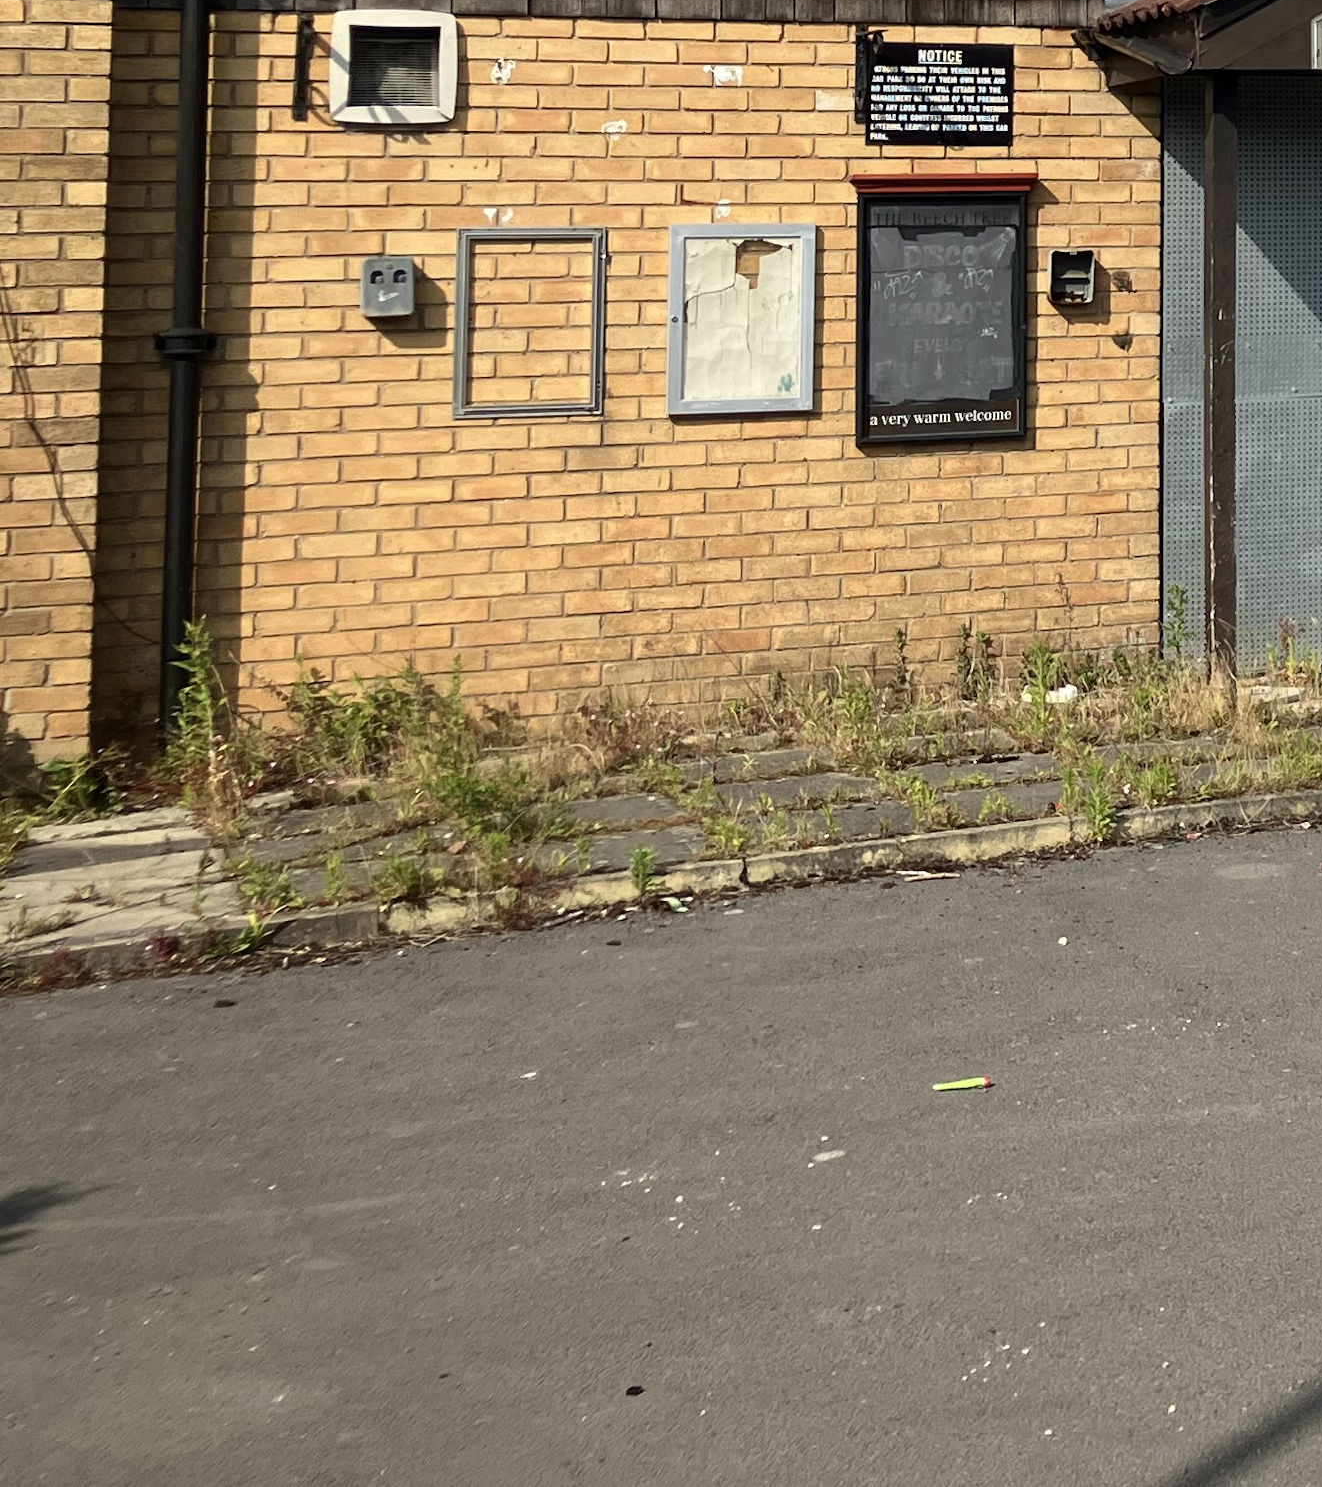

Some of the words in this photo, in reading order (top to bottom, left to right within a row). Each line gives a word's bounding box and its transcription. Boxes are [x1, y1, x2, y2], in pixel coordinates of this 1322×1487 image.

[918, 49, 963, 62] NOTICE
[900, 66, 927, 74] PARKING
[929, 66, 948, 74] THEIR
[950, 67, 980, 75] VEHICLES
[991, 67, 1006, 75] THIS
[928, 76, 936, 84] AT
[939, 76, 958, 84] THEIR
[976, 76, 992, 85] RISK
[993, 76, 1006, 84] AND
[978, 86, 987, 94] TO
[989, 86, 1001, 94] THE
[962, 95, 974, 103] THE
[977, 95, 1008, 103] PREMISES
[899, 104, 916, 112] LOSS
[874, 212, 905, 225] THE
[912, 211, 966, 225] BEECH
[903, 245, 980, 267] DISCO
[870, 416, 878, 426] a
[882, 414, 911, 427] very
[913, 412, 952, 424] warm
[954, 409, 1012, 423] welcome
